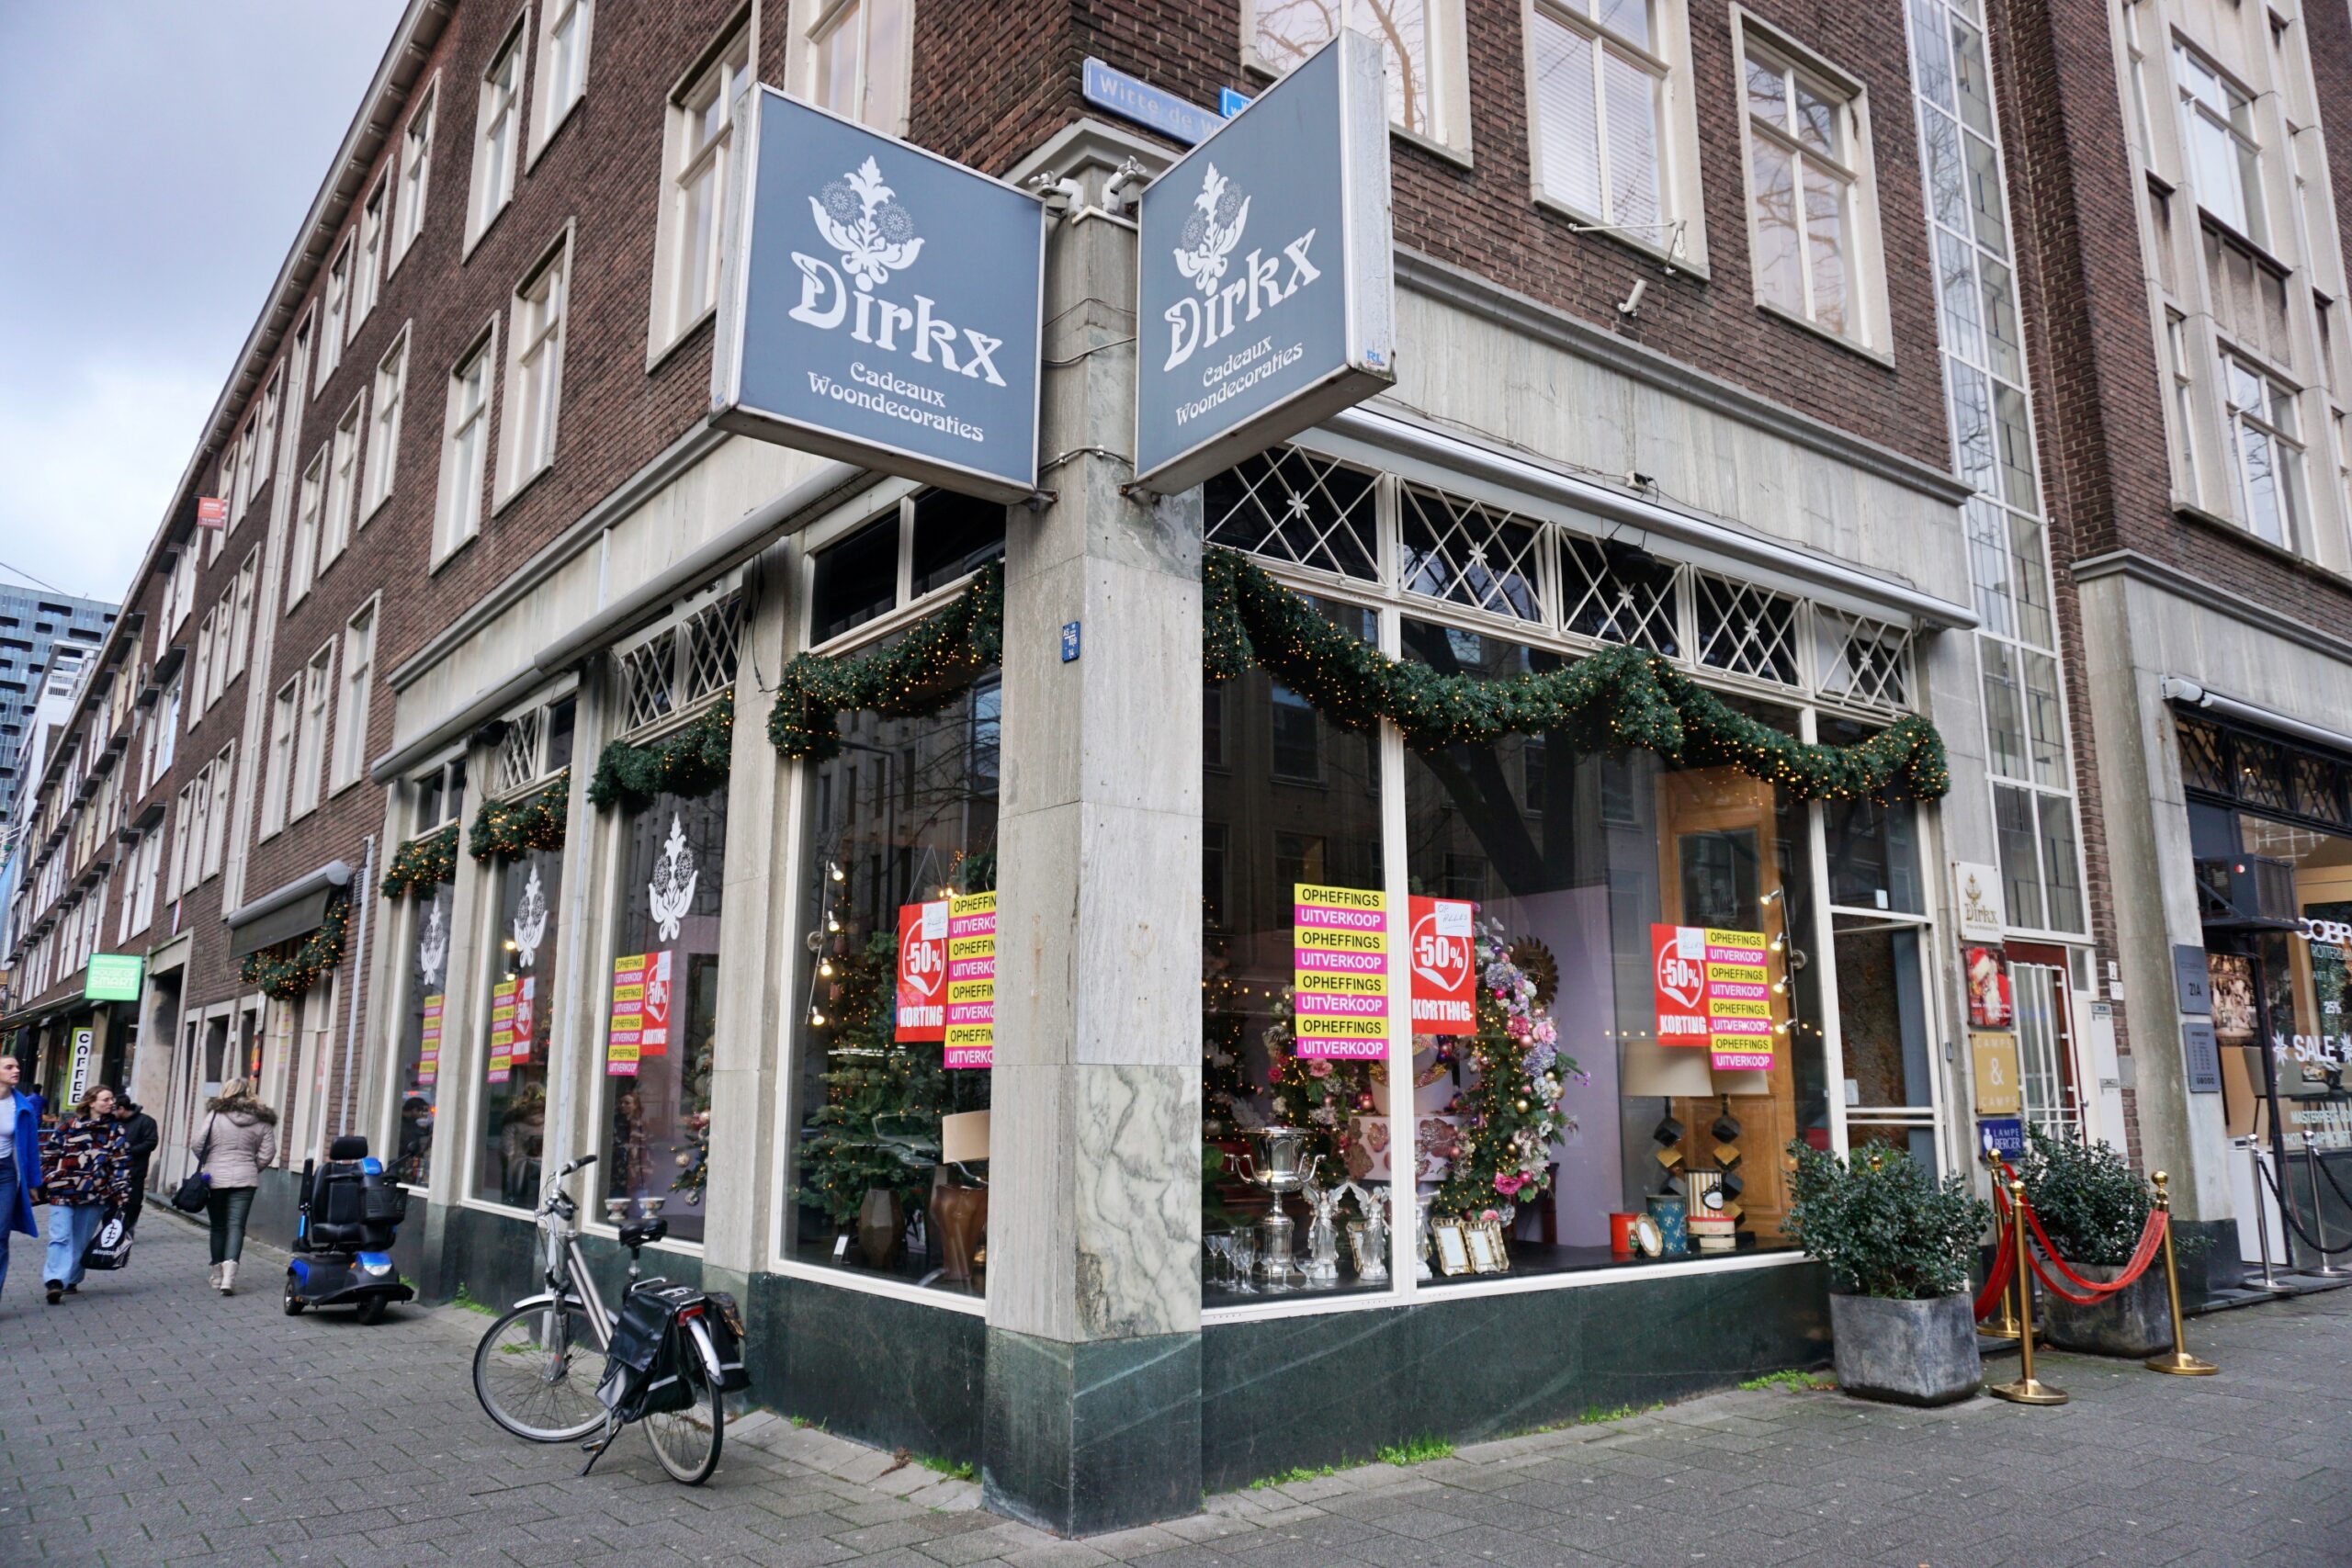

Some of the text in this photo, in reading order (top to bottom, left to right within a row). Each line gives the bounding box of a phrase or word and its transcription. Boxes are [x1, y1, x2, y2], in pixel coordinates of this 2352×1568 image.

[1100, 73, 1159, 111] Witte
[1169, 107, 1192, 126] de
[1162, 228, 1321, 372] Dirkx
[787, 251, 1007, 387] Dirkx
[1202, 336, 1272, 388] Cadeaux
[850, 362, 946, 408] Cadeaux
[1175, 342, 1304, 426] Woondecoraties
[807, 371, 985, 442] Woondecoraties
[1302, 888, 1379, 907] OPHEFFINGS
[1301, 908, 1381, 928] UITVERKOOP
[1964, 903, 1998, 924] Dirkx
[1302, 931, 1380, 949] OPHEFFINGS
[1711, 931, 1761, 946] OPHEFFINGS
[906, 941, 942, 975] -50%
[1301, 953, 1382, 969] UITVERKOOP
[1415, 935, 1463, 969] -50%
[1710, 950, 1763, 963] UITVERKOOP
[1662, 958, 1699, 988] -50%
[1712, 967, 1764, 980] OPHEFFINGS
[1303, 976, 1382, 992] OPHEFFINGS
[1712, 984, 1764, 997] UITVERKOOP
[1302, 996, 1383, 1012] UITVERKOOP
[1412, 998, 1470, 1021] KORTING
[1713, 1002, 1766, 1015] OPHEFFINGS
[2324, 1000, 2342, 1014] 25%
[899, 1005, 944, 1028] KORTING
[1660, 1015, 1707, 1034] KORTING
[1713, 1019, 1768, 1032] UITVERKOOP
[1303, 1020, 1382, 1034] OPHEFFINGS
[1303, 1040, 1384, 1055] UITVERKOOP
[1716, 1038, 1769, 1049] OPHEFFINGS
[2292, 1034, 2337, 1063] SALE
[72, 1033, 90, 1103] COFFEE
[1716, 1055, 1770, 1067] UITVERKOOP
[1991, 1057, 2005, 1085] &
[1994, 1128, 2019, 1138] LAMPE
[1995, 1138, 2020, 1149] BERGER
